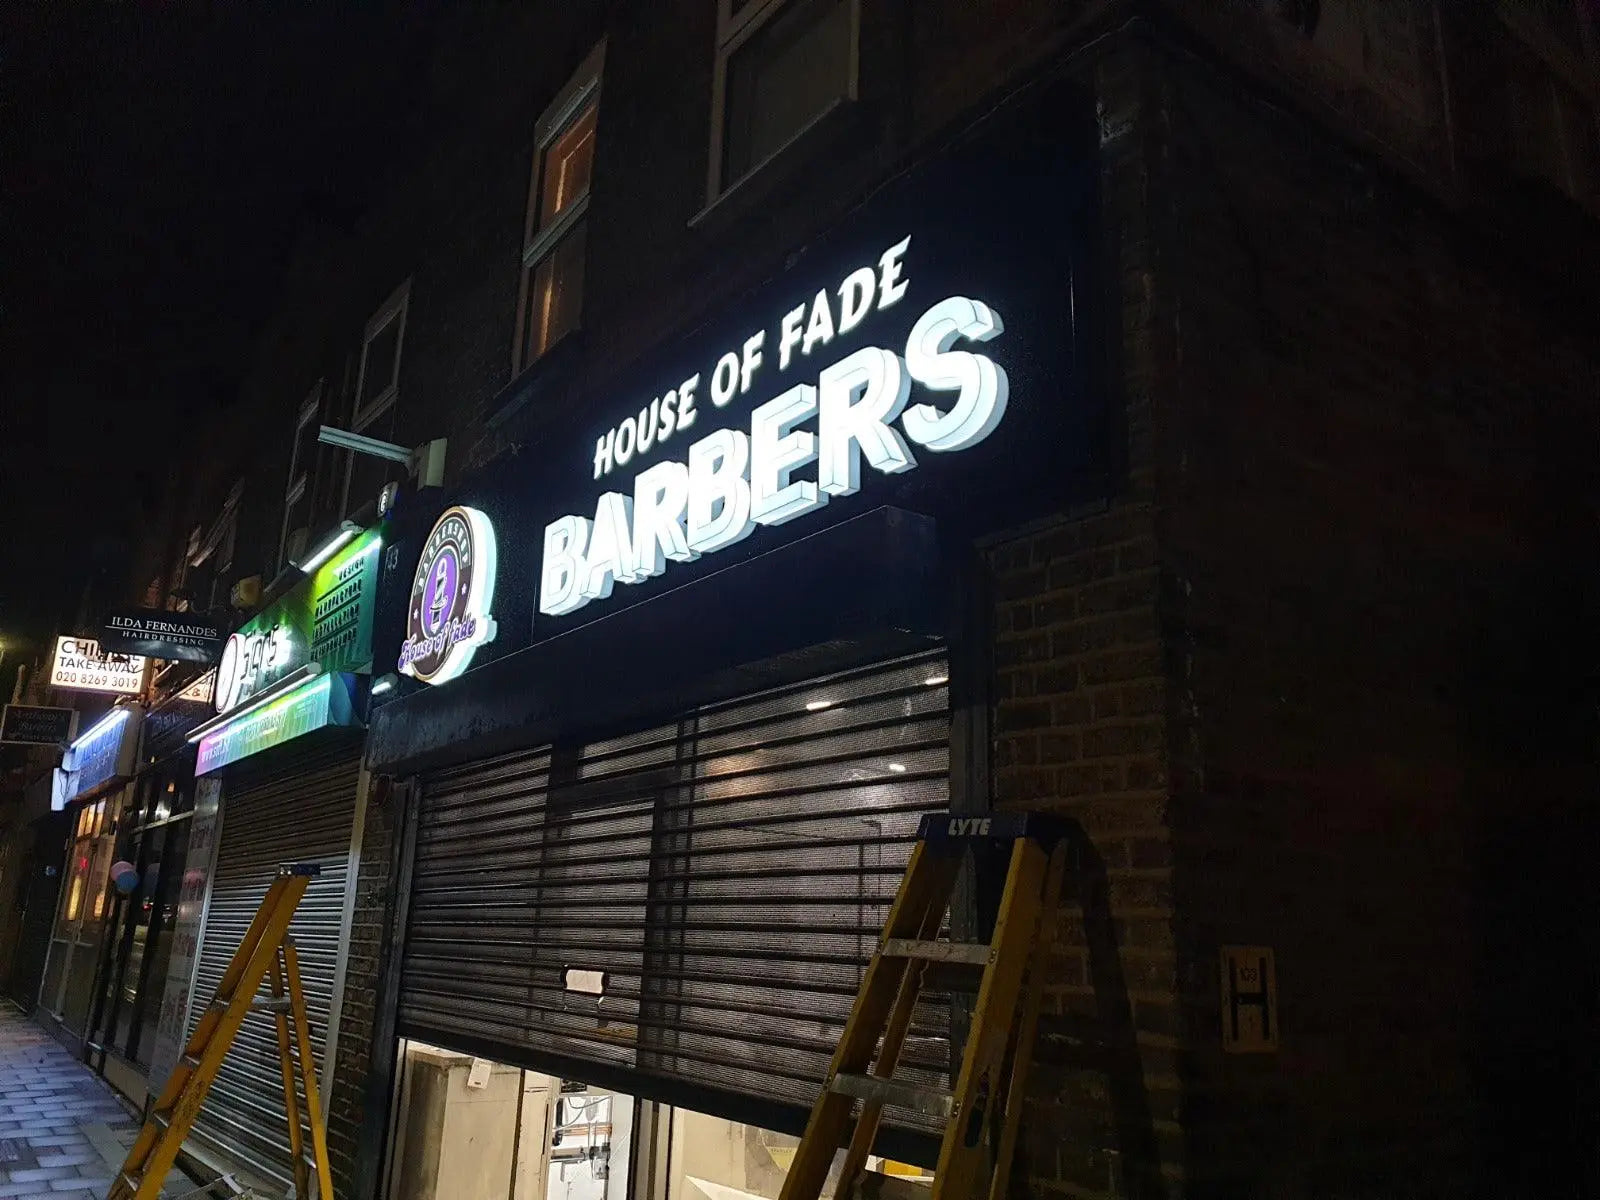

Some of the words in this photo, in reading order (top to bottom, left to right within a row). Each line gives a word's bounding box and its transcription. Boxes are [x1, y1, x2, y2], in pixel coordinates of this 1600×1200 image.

[592, 372, 701, 480] HOUSE
[709, 328, 767, 409] OF
[778, 233, 912, 371] FADE
[538, 294, 1010, 617] BARBERS
[417, 521, 469, 589] BARBERSHOP
[111, 616, 142, 629] ILDA
[145, 620, 217, 638] FERNANDES
[122, 630, 205, 647] HAIRDRESSING
[59, 656, 94, 670] TAKE
[97, 660, 139, 674] AWAY
[55, 671, 77, 683] 020
[80, 673, 108, 686] 8269
[111, 676, 138, 689] 3019
[948, 817, 993, 836] LYTE
